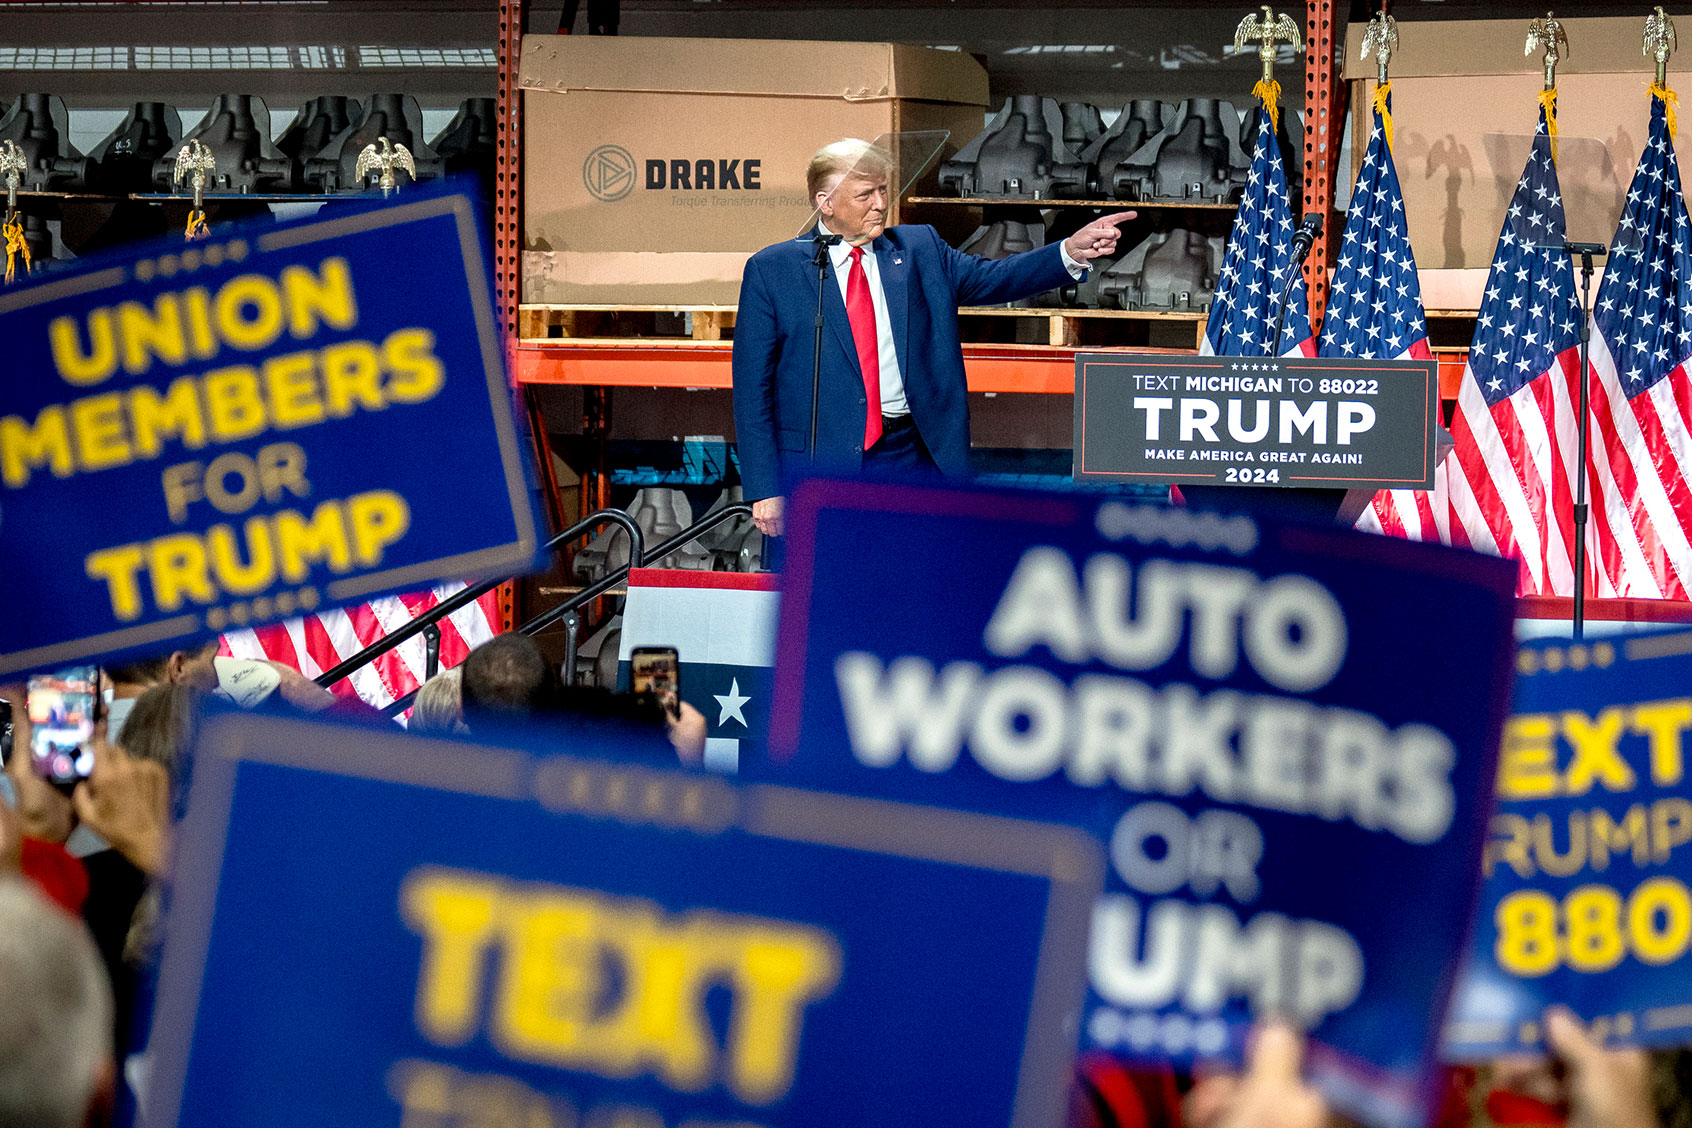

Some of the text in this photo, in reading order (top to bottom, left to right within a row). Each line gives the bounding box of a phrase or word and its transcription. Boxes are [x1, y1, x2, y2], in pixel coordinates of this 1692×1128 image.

[645, 159, 761, 190] DRAKE
[671, 195, 812, 209] Torque Transferring Produ
[48, 256, 360, 387] UNION
[0, 326, 446, 489] MEMBERS
[1132, 374, 1379, 395] TEXT MICHIGAN TO 88022
[1133, 396, 1377, 445] TRUMP
[161, 441, 312, 524] FOR
[1144, 449, 1363, 465] MAKE AMERICA GREAT AGAIN!
[1225, 467, 1280, 484] 2024
[85, 489, 411, 621] TRUMP
[982, 544, 1349, 694] AUTO
[833, 649, 1458, 847] WORKERS
[1496, 698, 1692, 799] EXT
[1110, 799, 1266, 904] OR
[1494, 875, 1692, 977] 880
[398, 862, 844, 1109] TEXT
